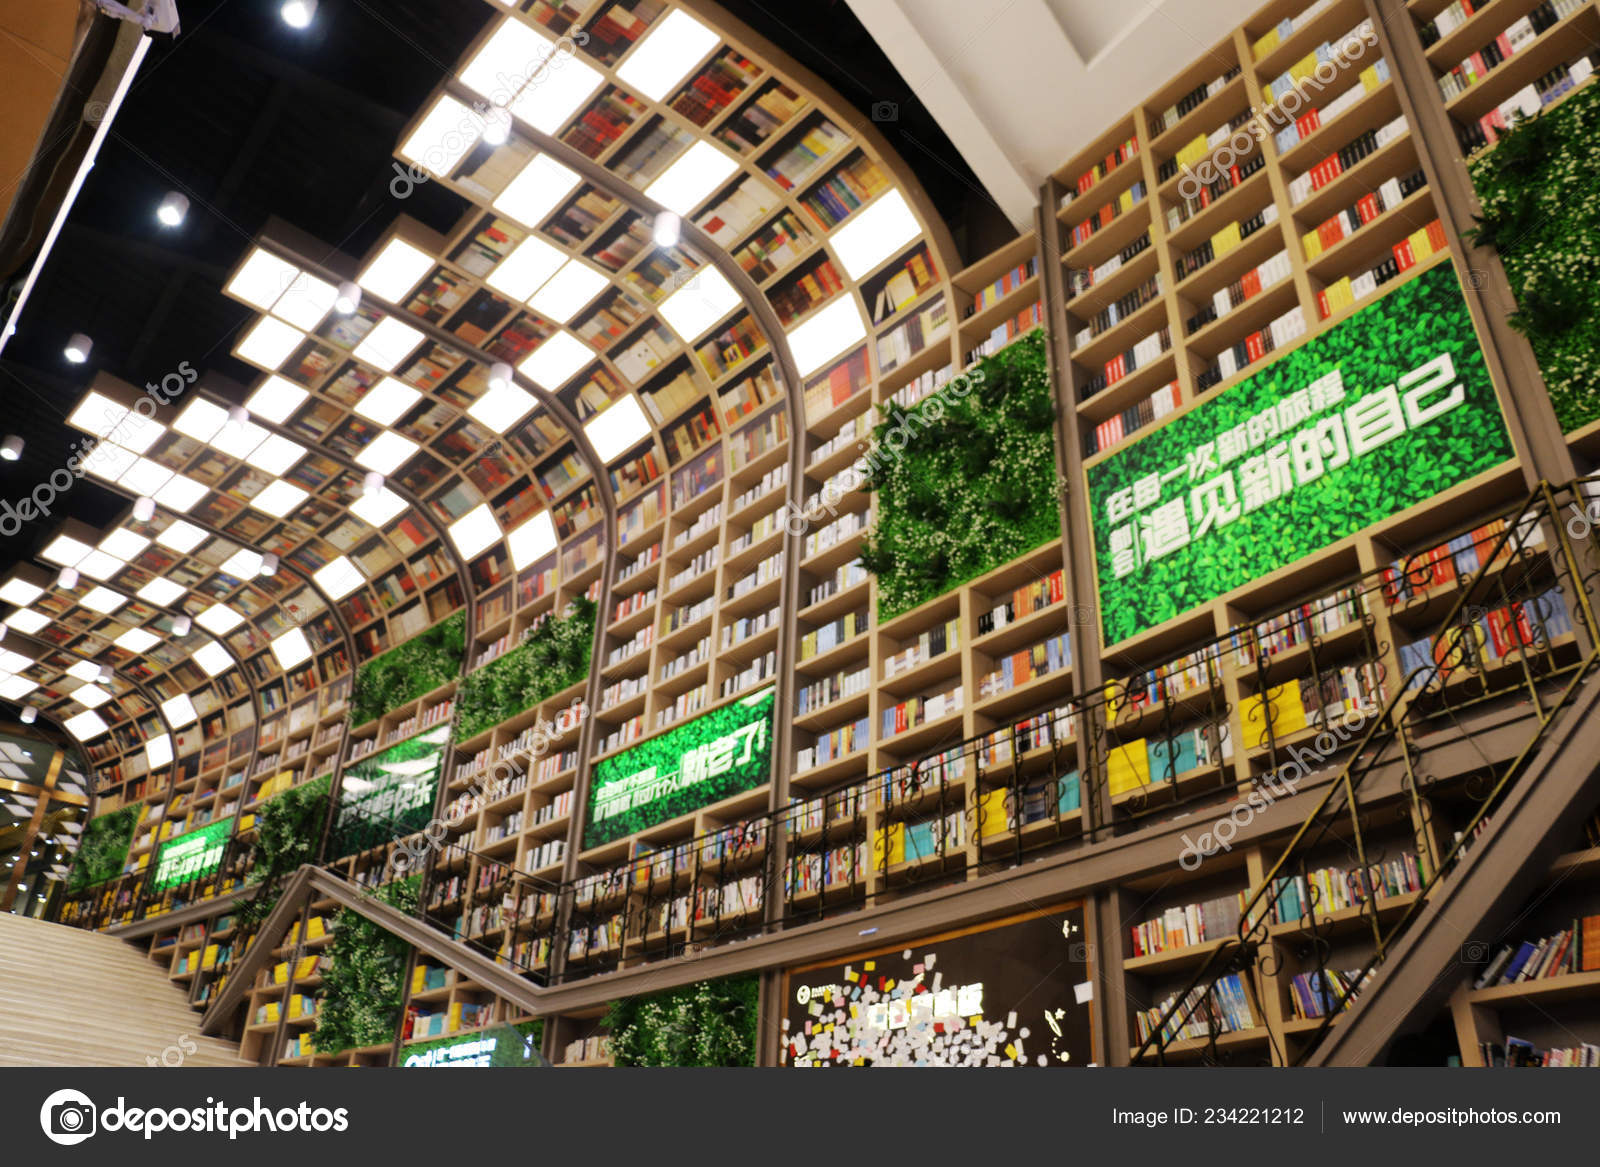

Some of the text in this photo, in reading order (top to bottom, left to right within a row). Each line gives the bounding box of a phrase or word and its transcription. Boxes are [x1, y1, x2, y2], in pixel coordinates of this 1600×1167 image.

[1105, 369, 1346, 524] 在每一次新的旅程
[1140, 352, 1465, 561] 遇见新的自己
